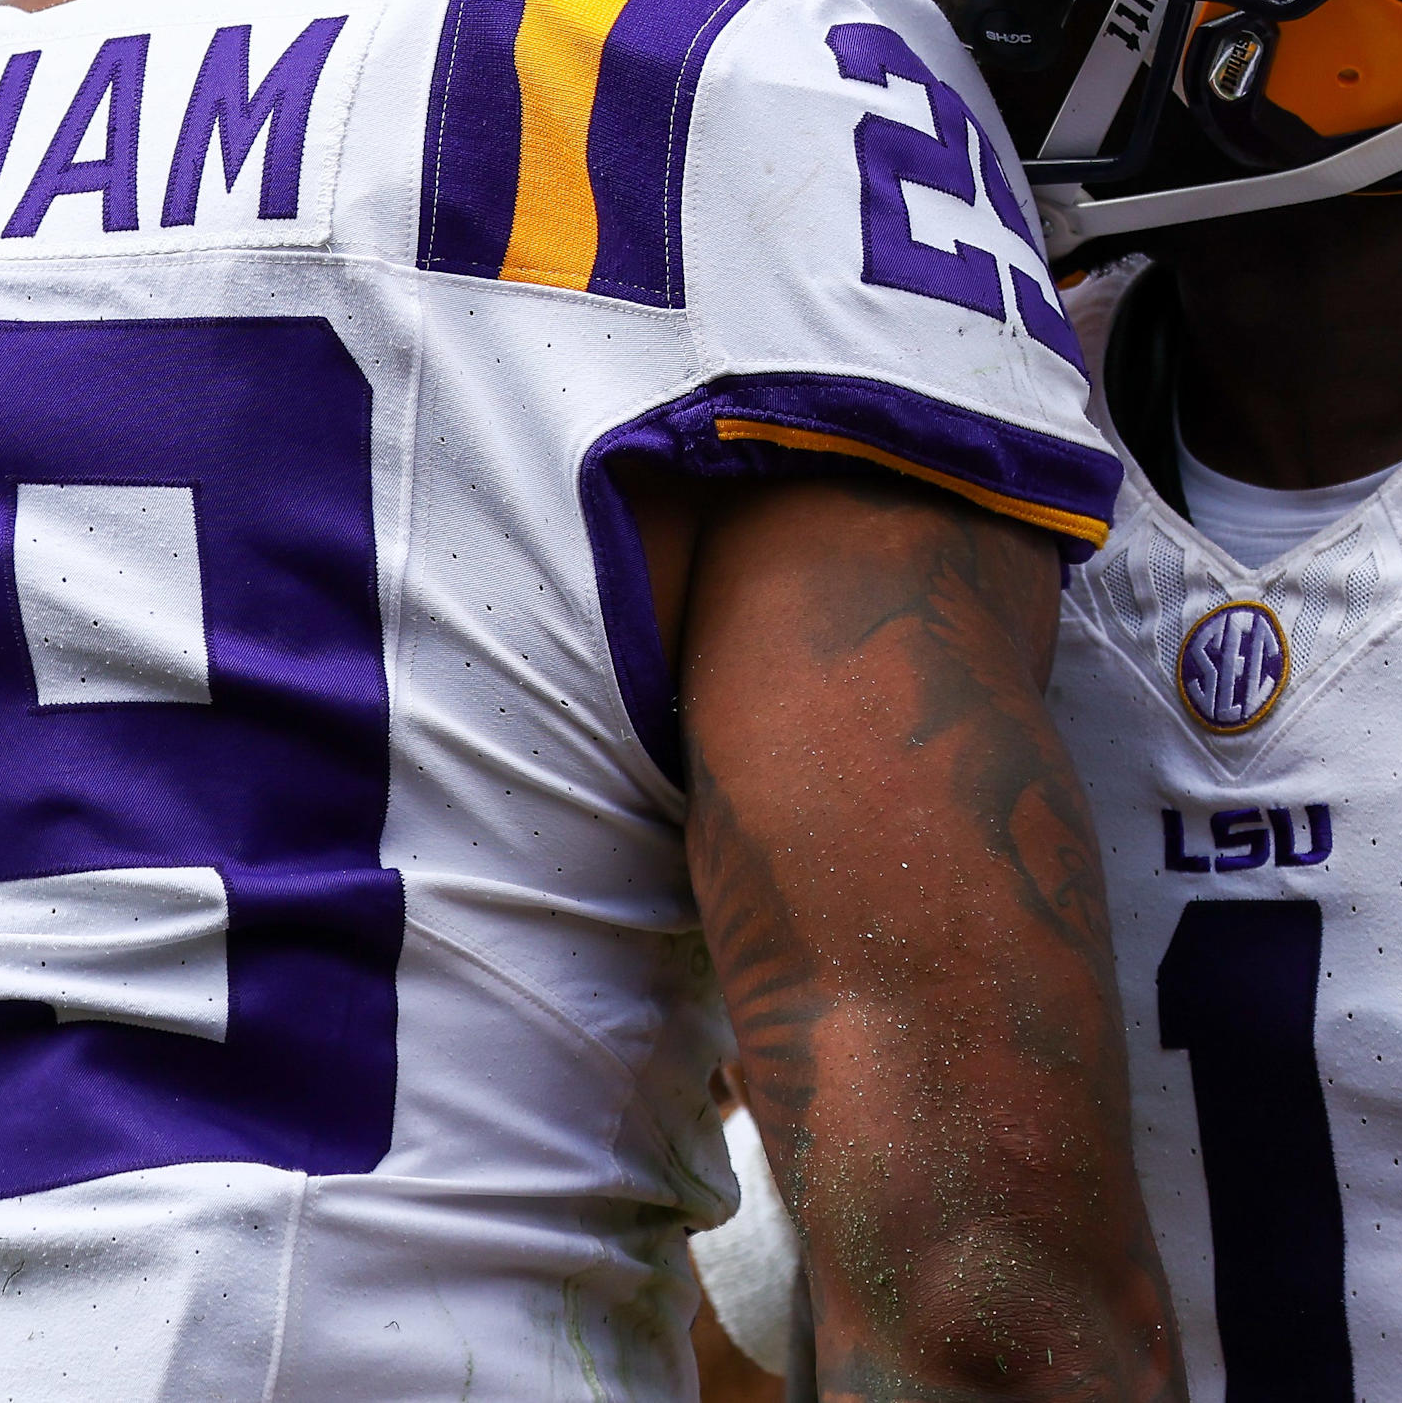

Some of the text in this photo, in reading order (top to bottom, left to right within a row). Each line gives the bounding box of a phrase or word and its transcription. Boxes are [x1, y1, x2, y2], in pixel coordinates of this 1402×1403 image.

[1185, 609, 1281, 724] SEC
[1161, 803, 1333, 874] LSU
[1156, 898, 1356, 1403] 1
